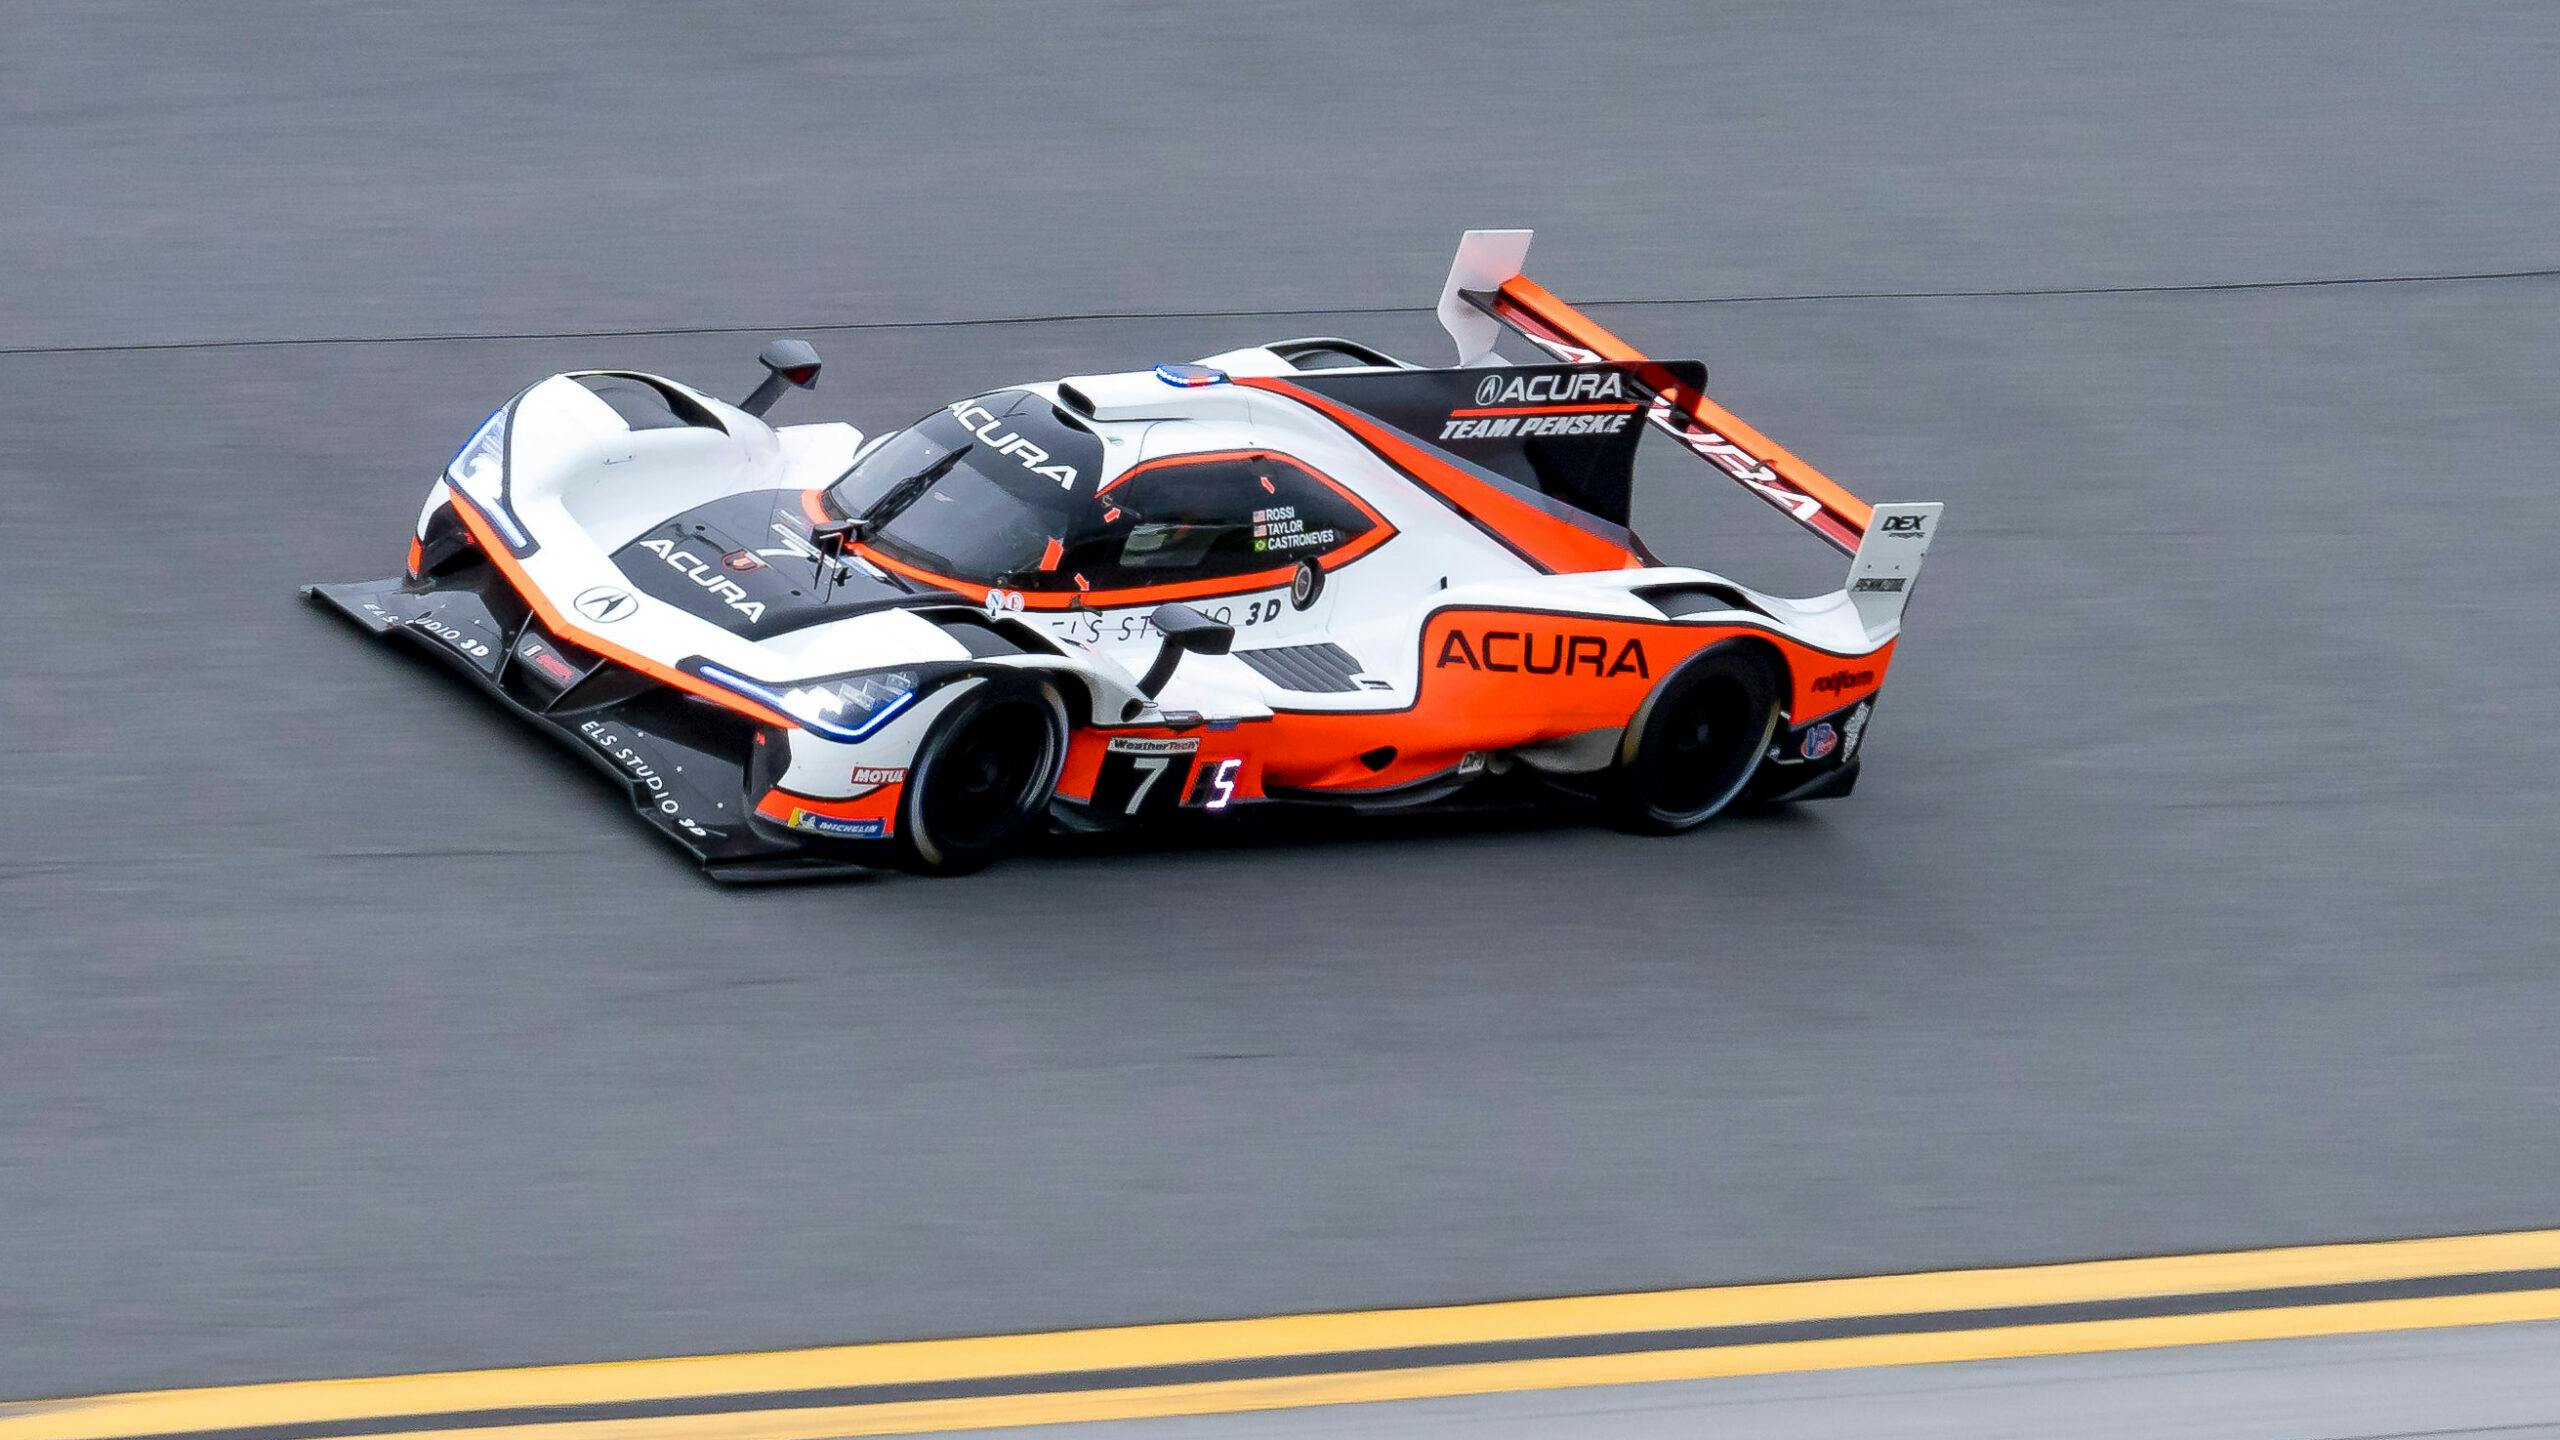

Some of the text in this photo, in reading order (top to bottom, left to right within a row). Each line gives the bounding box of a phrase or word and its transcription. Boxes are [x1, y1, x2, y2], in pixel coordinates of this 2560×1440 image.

[1500, 373, 1624, 402] ACURA
[1439, 414, 1631, 440] TEAM PENSKE
[949, 400, 1078, 491] ACURA
[1266, 505, 1295, 521] ROSSI
[1881, 515, 1927, 531] DEX
[1267, 520, 1304, 536] TAYLOR
[1268, 529, 1334, 551] CASTRONEVES
[640, 539, 766, 624] ACURA
[1245, 599, 1281, 626] 3D
[460, 639, 489, 657] 3D
[1436, 629, 1649, 679] ACURA
[1113, 740, 1198, 751] WeatherTech
[581, 720, 618, 746] ELS
[615, 748, 679, 814] STUDIO
[853, 768, 904, 783] MOTUL
[1125, 757, 1170, 815] 7
[819, 821, 879, 833] MICHELIN
